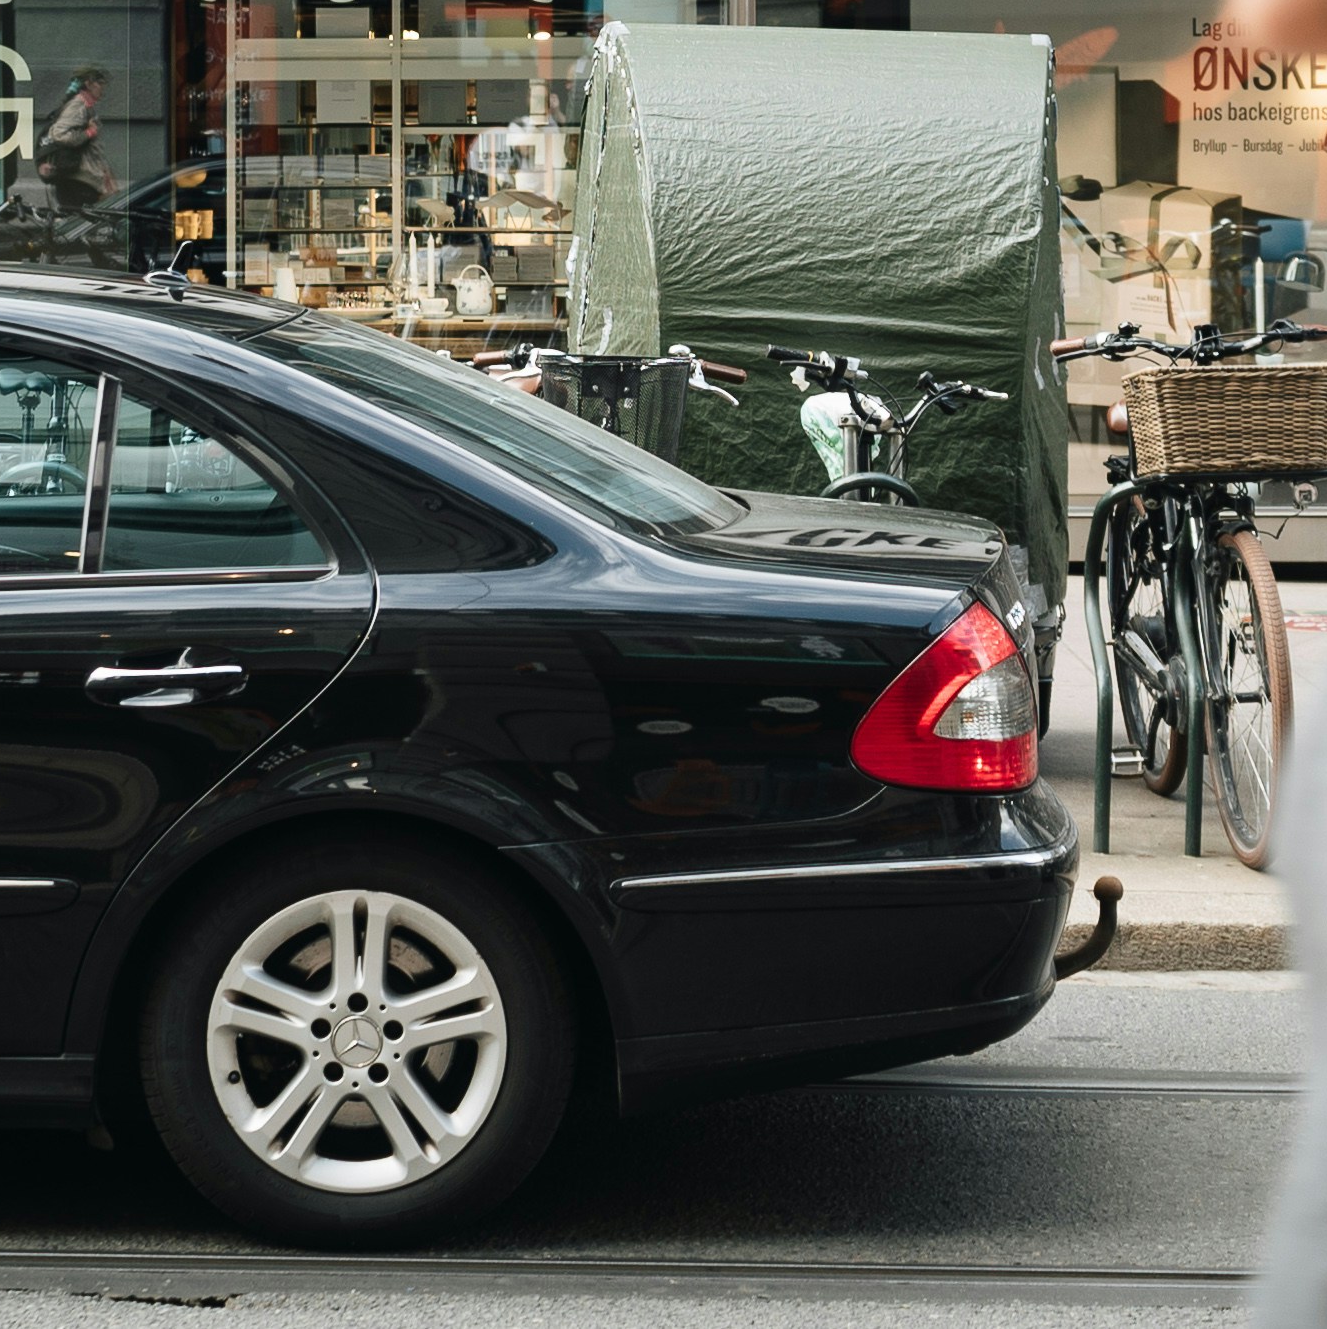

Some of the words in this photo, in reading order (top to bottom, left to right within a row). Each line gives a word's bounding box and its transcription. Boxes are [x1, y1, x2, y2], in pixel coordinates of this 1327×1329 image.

[1192, 18, 1222, 40] Lag
[1193, 102, 1222, 121] hos
[1193, 138, 1227, 155] Bryllup
[1244, 138, 1283, 155] Bursdag
